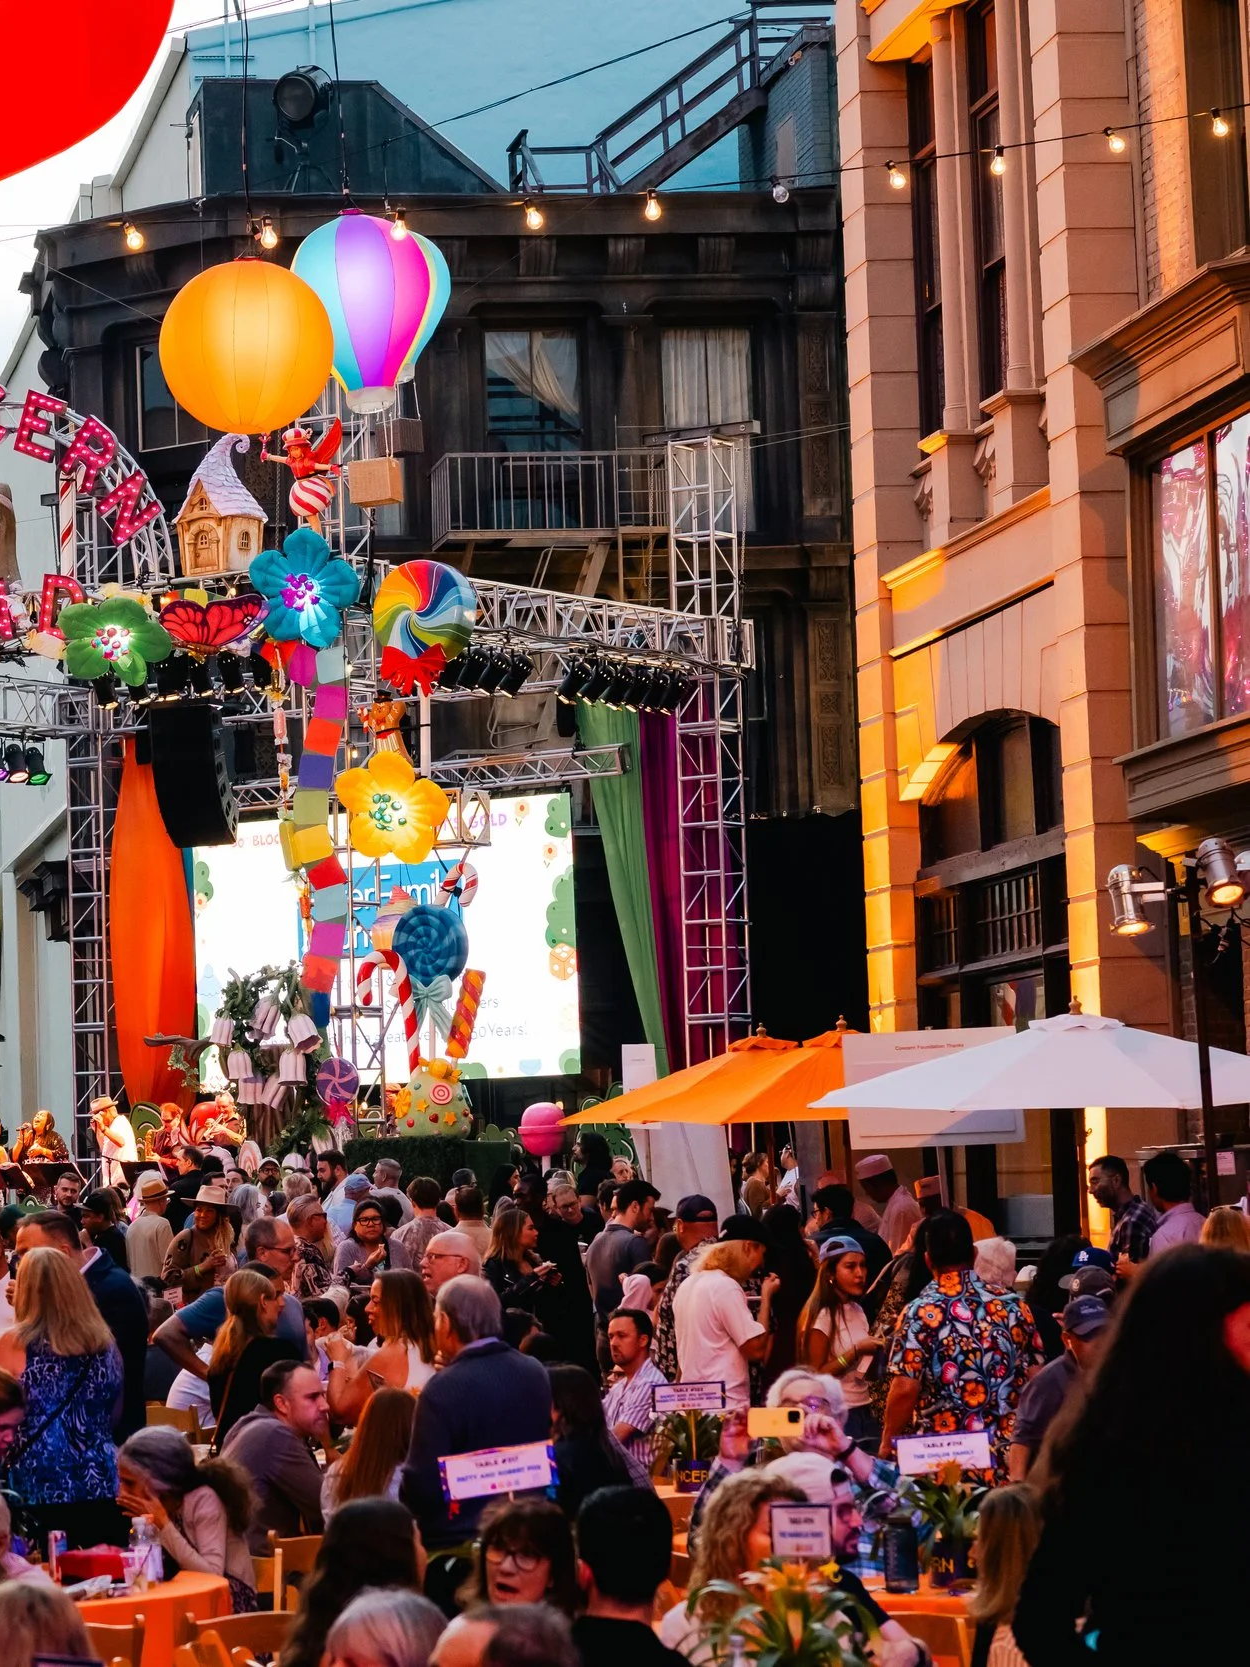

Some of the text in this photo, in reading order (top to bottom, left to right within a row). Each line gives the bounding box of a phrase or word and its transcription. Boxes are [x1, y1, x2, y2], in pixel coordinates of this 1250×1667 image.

[252, 833, 280, 846] BLOC
[469, 813, 508, 829] GOLD
[475, 1459, 499, 1469] TABLE
